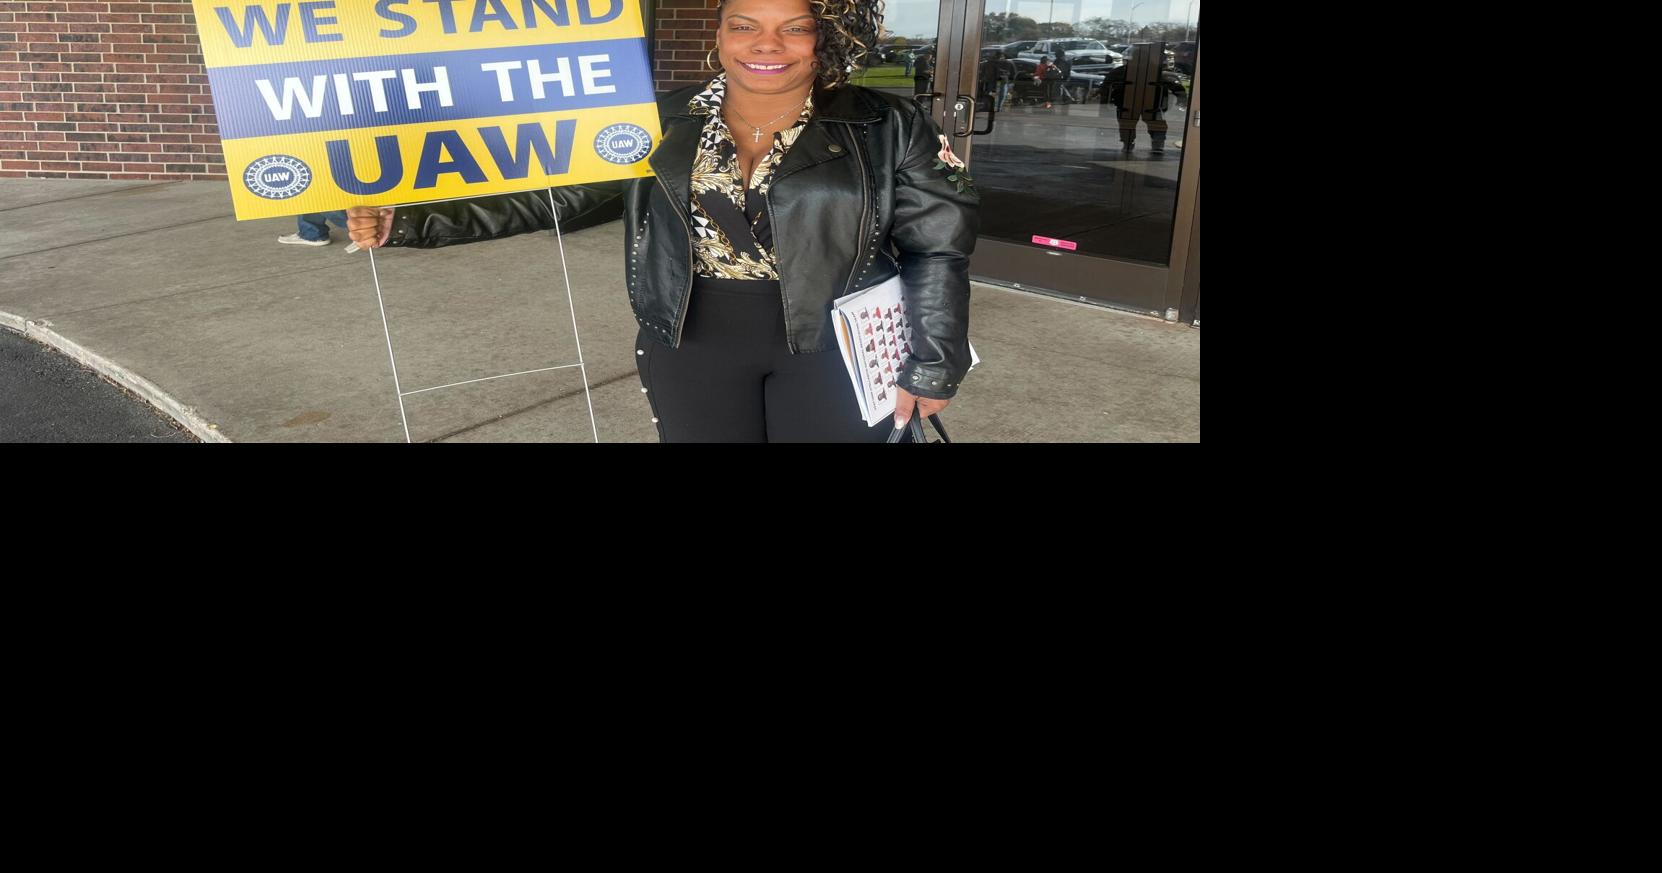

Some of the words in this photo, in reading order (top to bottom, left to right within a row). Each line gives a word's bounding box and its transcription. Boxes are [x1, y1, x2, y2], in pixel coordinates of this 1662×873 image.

[213, 0, 344, 48] WE
[374, 0, 624, 38] STAND
[255, 66, 454, 121] WITH
[481, 53, 616, 103] THE
[325, 119, 577, 196] UAW
[611, 138, 634, 149] UAW
[264, 171, 290, 183] UAW
